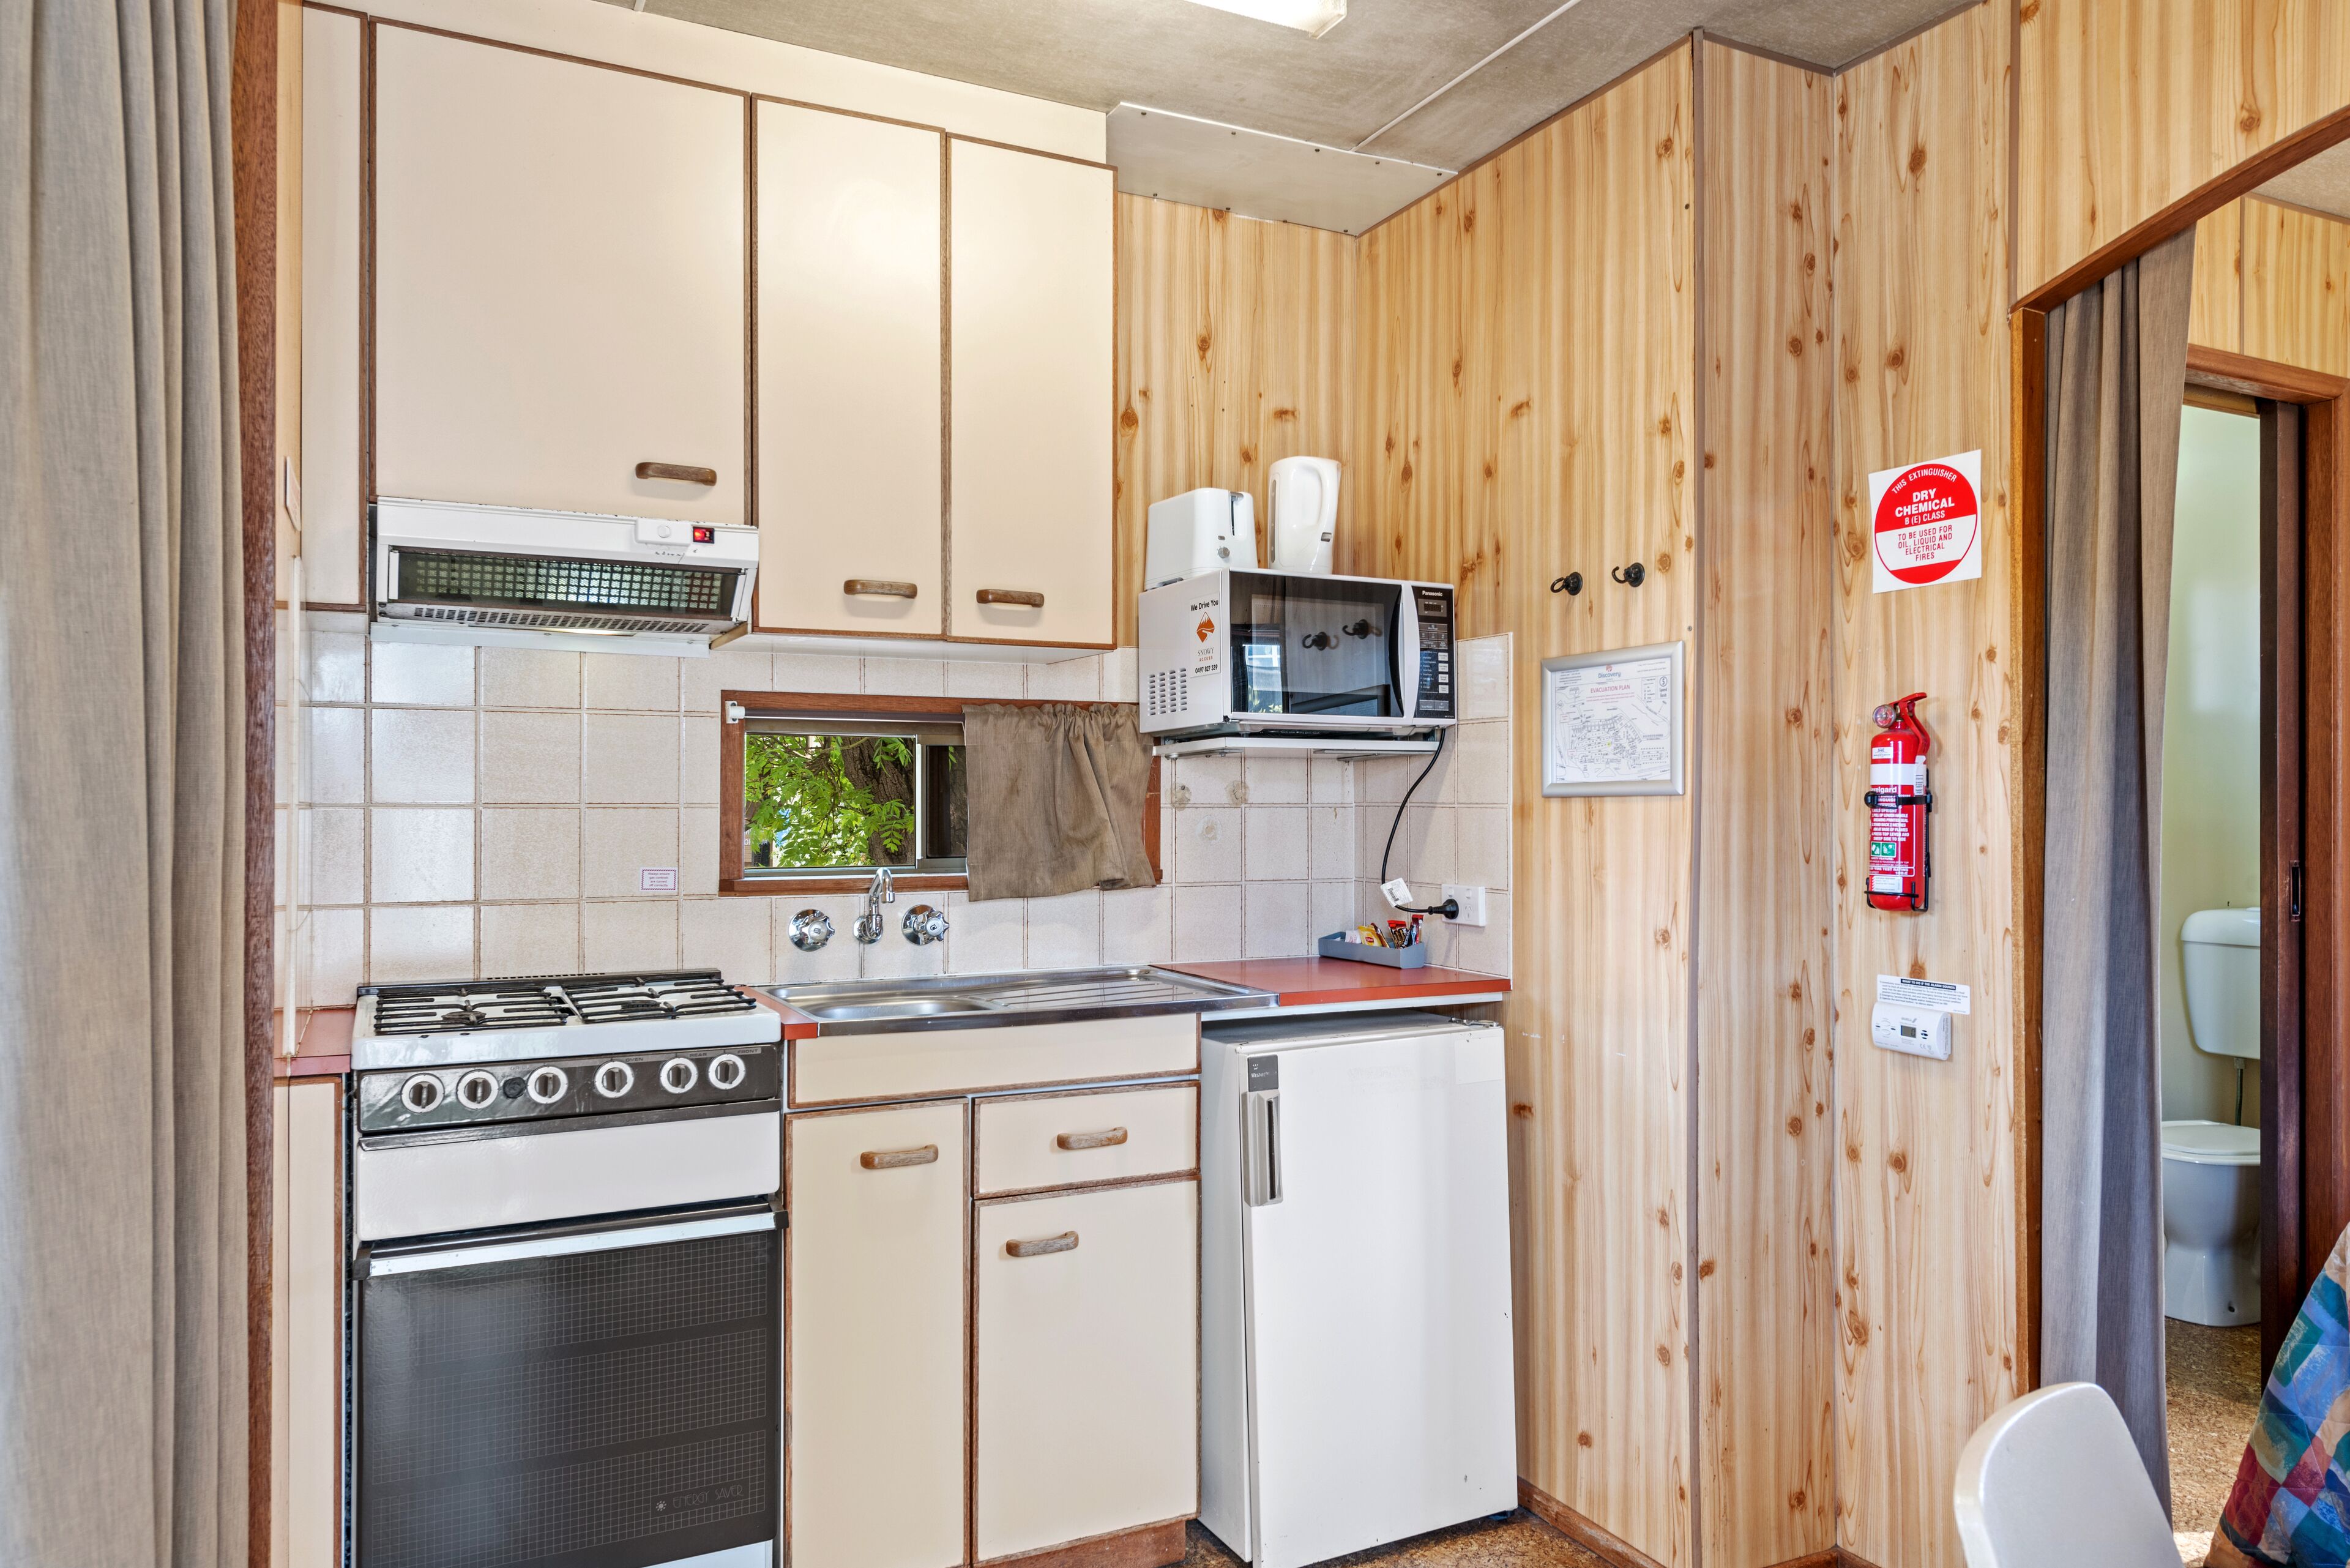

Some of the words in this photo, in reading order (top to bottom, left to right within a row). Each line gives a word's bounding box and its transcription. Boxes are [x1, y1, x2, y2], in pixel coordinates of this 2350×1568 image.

[1892, 479, 1906, 494] THIS
[1908, 468, 1957, 482] EXTINGUISHER
[1912, 488, 1936, 502] DRY
[1895, 497, 1955, 517] CHEMICAL
[1904, 517, 1909, 525] B
[1911, 515, 1921, 525] (E)
[1923, 510, 1945, 521] CLASS
[1919, 529, 1936, 537] USED
[1939, 525, 1952, 533] FOR
[1914, 537, 1936, 546] LIQUID
[1939, 532, 1952, 541] AND
[1905, 544, 1945, 555] ELECTRICAL
[1915, 552, 1934, 561] FIRES
[1199, 601, 1210, 610] Drive
[1198, 647, 1214, 657] SNOWY
[673, 1490, 710, 1509] ENERGY
[715, 1484, 745, 1500] SAVER
